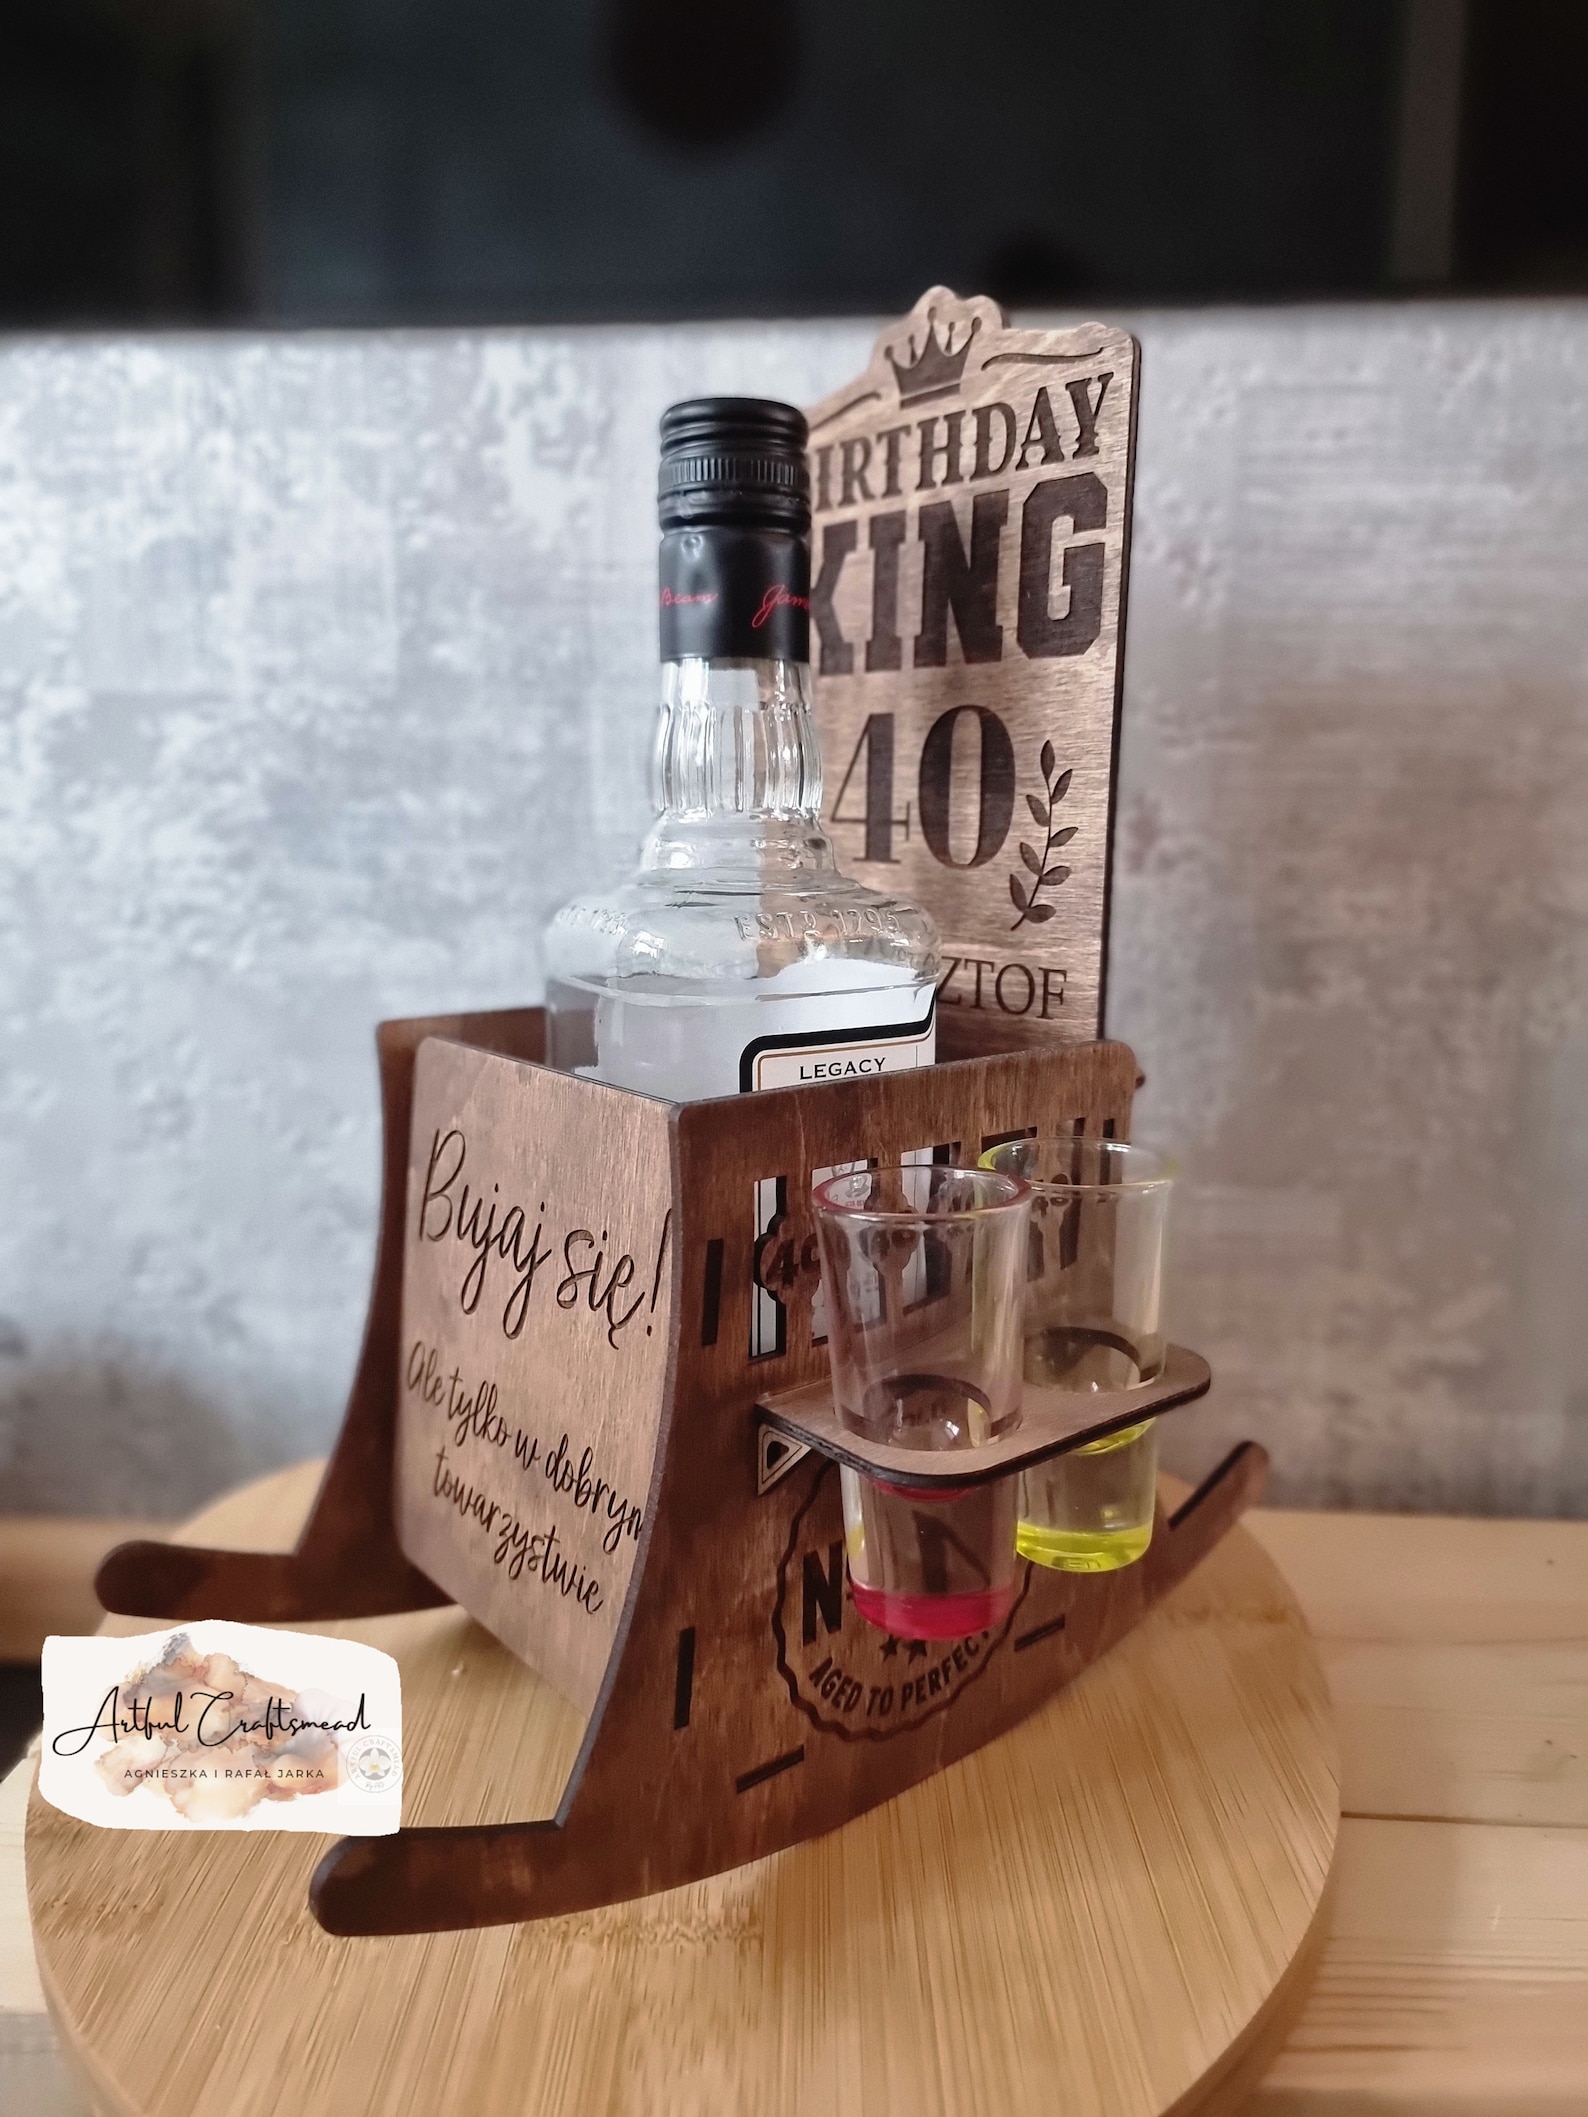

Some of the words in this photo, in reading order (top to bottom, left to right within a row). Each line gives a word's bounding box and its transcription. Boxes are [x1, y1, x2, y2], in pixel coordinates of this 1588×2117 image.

[812, 371, 1115, 513] IRTHDAY
[829, 704, 1016, 870] 40
[936, 955, 1068, 1020] ZTOF
[799, 1057, 887, 1081] LEGACY
[419, 1127, 553, 1340] Bujaj
[447, 1366, 513, 1447] tylko
[514, 1428, 541, 1470] w
[432, 1446, 604, 1615] towarzystwie
[808, 1656, 863, 1713] AGED
[866, 1686, 895, 1716] TO
[901, 1630, 989, 1712] PERFEC
